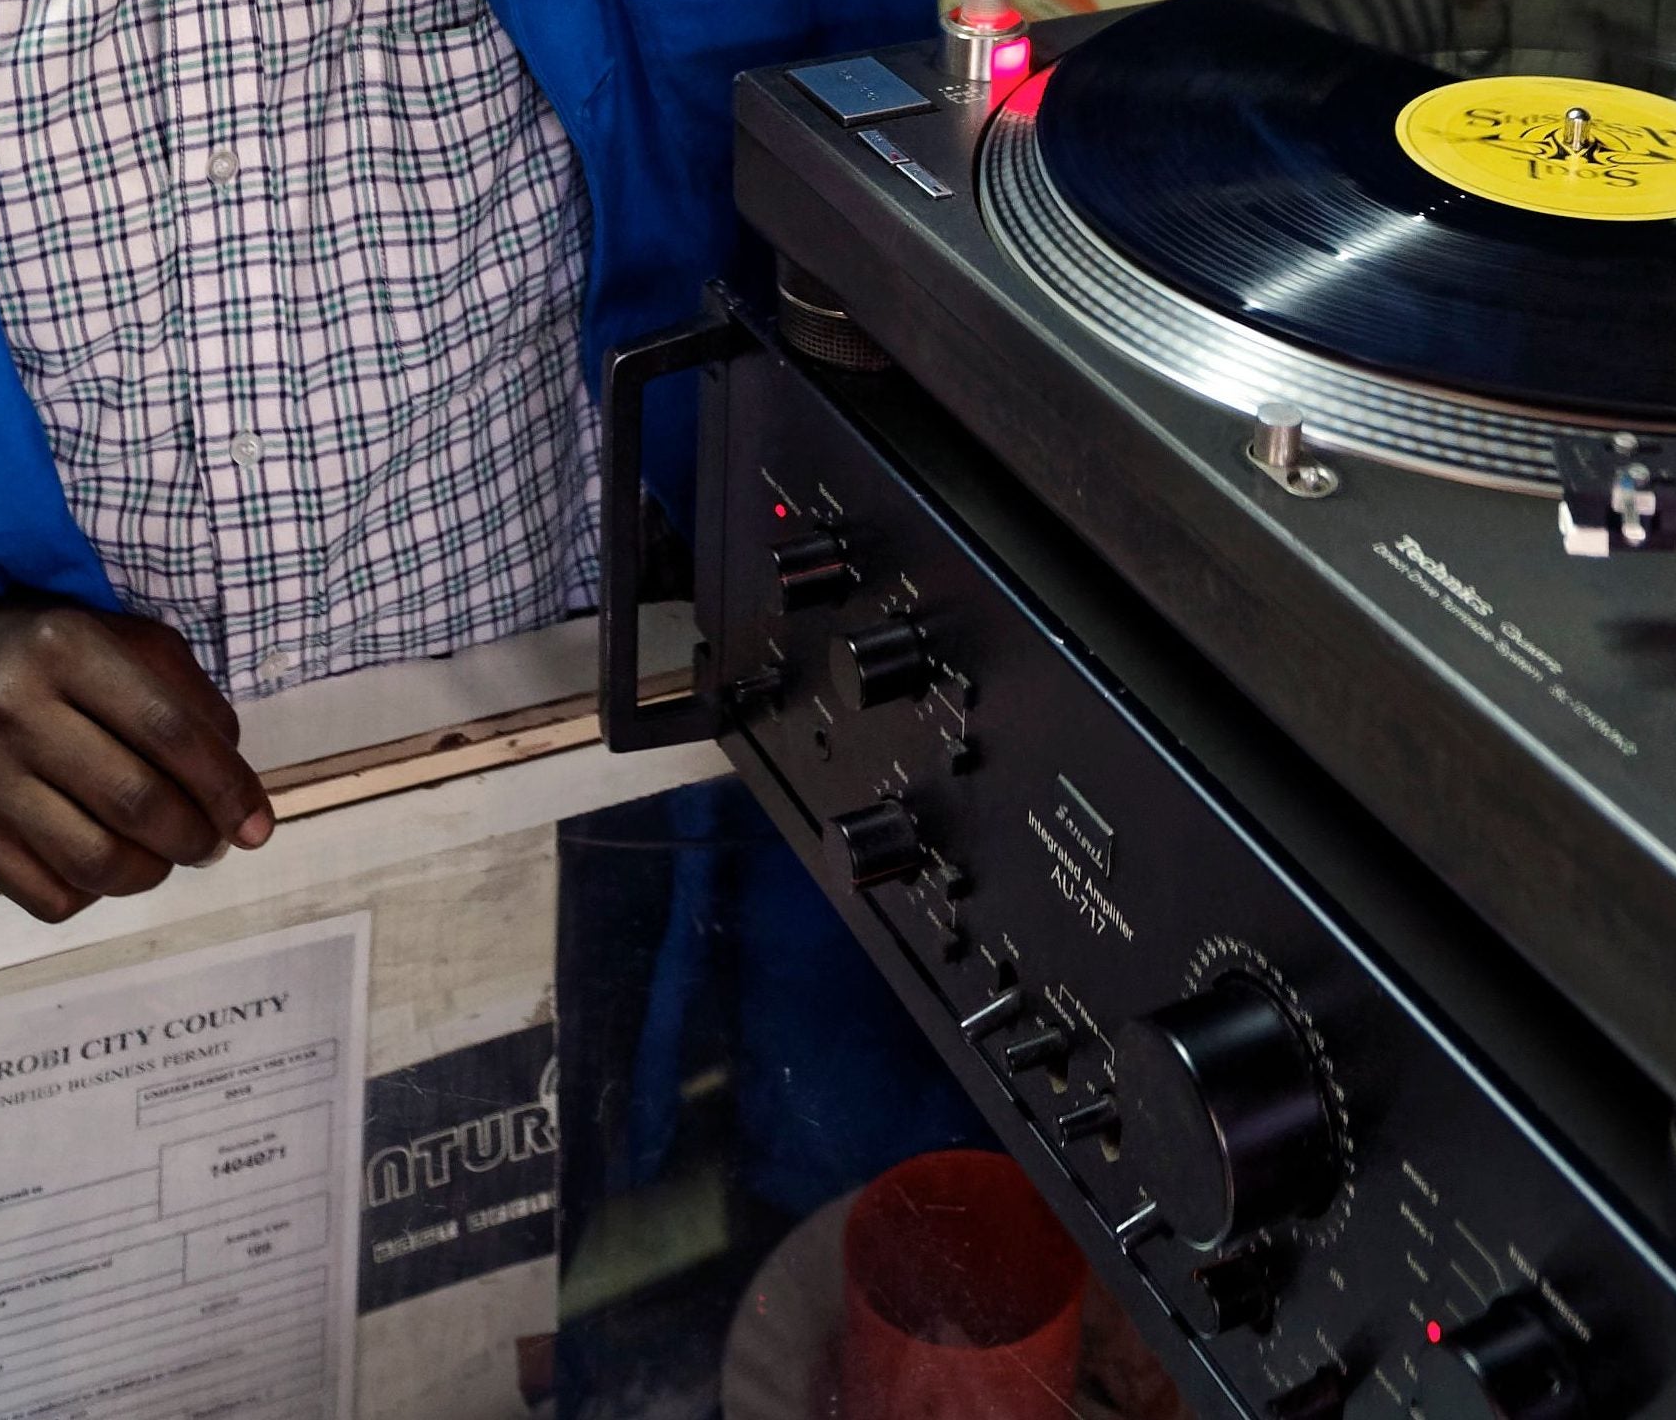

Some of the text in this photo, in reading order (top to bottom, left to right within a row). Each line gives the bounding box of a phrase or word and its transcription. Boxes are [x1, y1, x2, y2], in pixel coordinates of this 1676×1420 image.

[1395, 533, 1495, 617] Technics
[1028, 809, 1136, 943] Integrated Amplifier
[1050, 864, 1107, 936] AU-717
[79, 1024, 158, 1061] CITY
[163, 991, 291, 1041] COUNTY
[67, 1059, 157, 1094] BUSINESS
[161, 1040, 232, 1069] PERMIT
